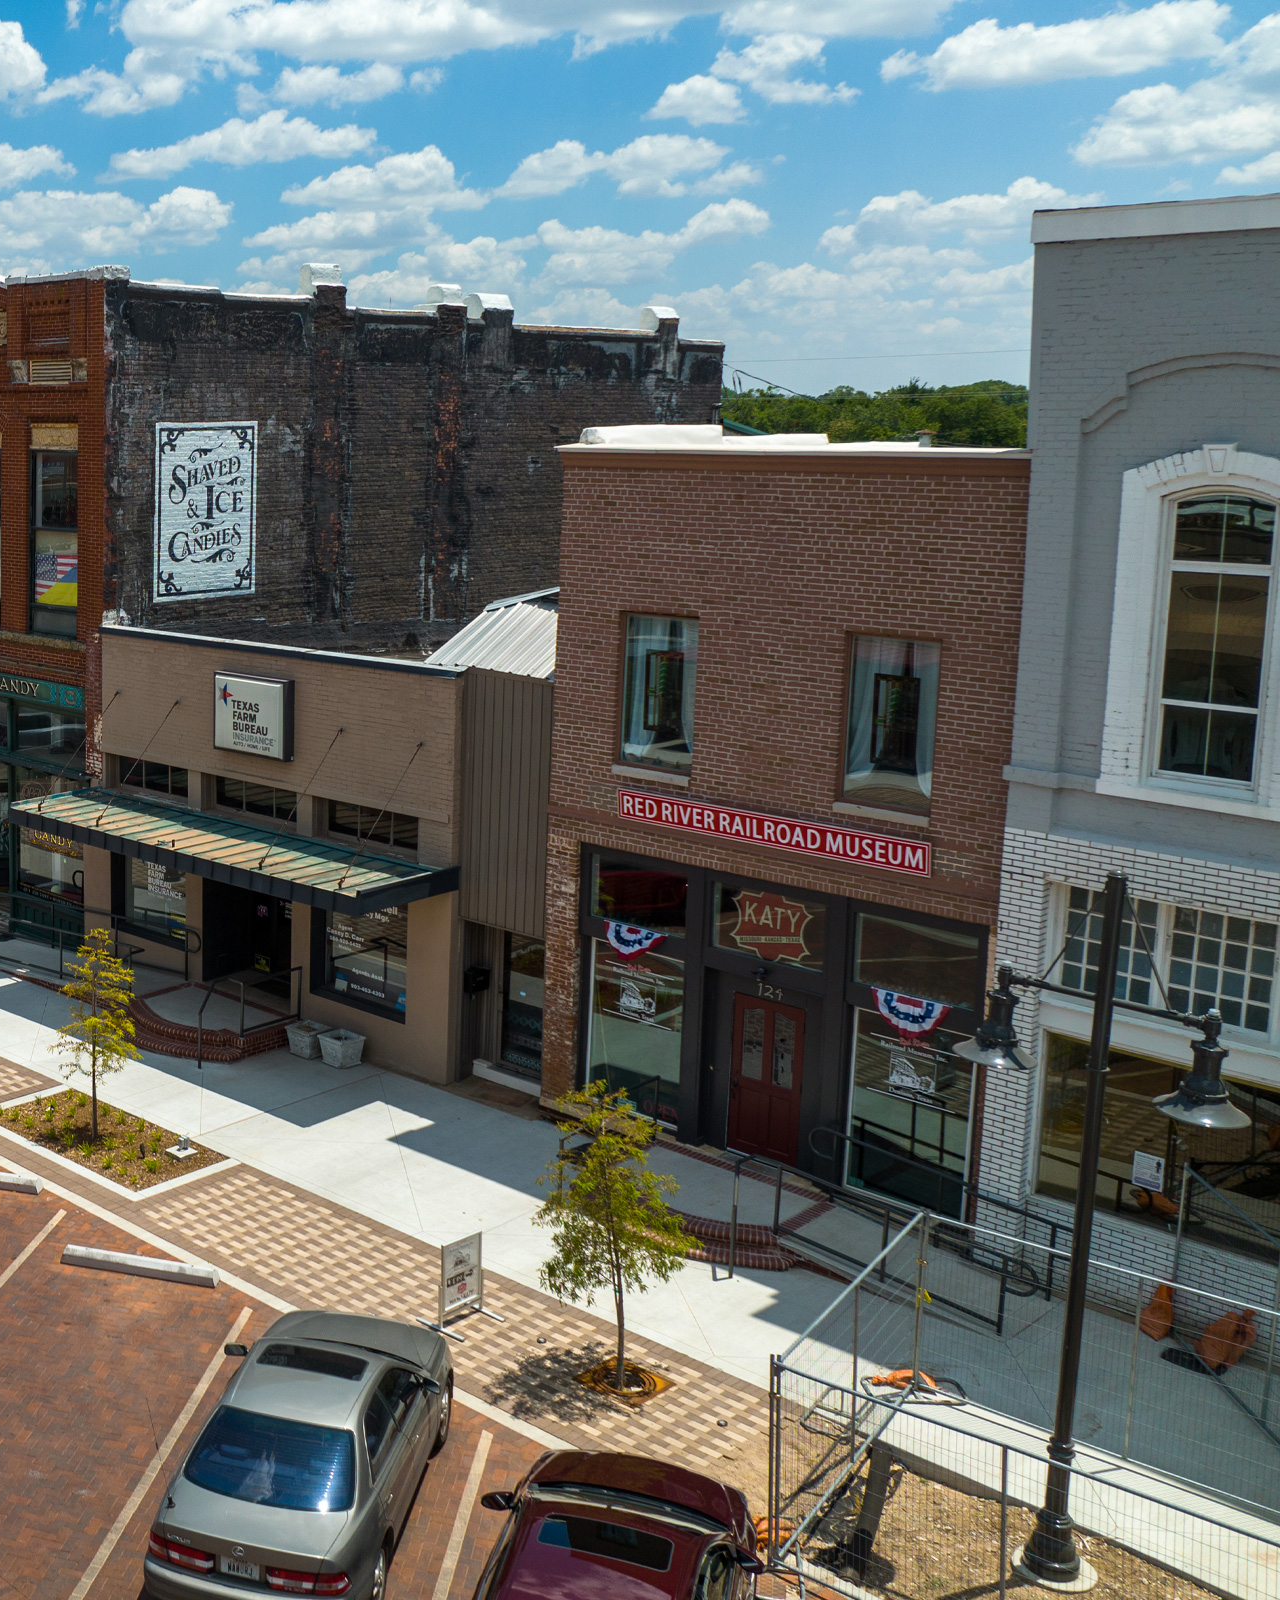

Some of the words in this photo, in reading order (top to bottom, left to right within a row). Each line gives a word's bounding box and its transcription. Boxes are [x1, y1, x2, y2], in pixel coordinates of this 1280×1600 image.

[186, 498, 200, 519] &
[231, 700, 260, 713] TEXAS
[232, 710, 256, 724] FARM
[232, 722, 268, 736] BUREAU
[232, 732, 274, 747] INSURANCE
[622, 794, 658, 819] RED
[661, 802, 715, 831] RIVER
[719, 812, 821, 850] RAILROAD
[824, 831, 924, 870] MUSEUM
[147, 861, 166, 873] TEXAS
[147, 870, 165, 880] FARM
[147, 876, 172, 890] BUREAU
[147, 884, 182, 900] INSURANCE
[744, 900, 801, 934] KATY
[338, 924, 353, 932] Agent
[758, 982, 784, 1000] 124
[880, 1040, 906, 1052] Railroad
[900, 1036, 910, 1046] Red
[912, 1038, 930, 1048] River
